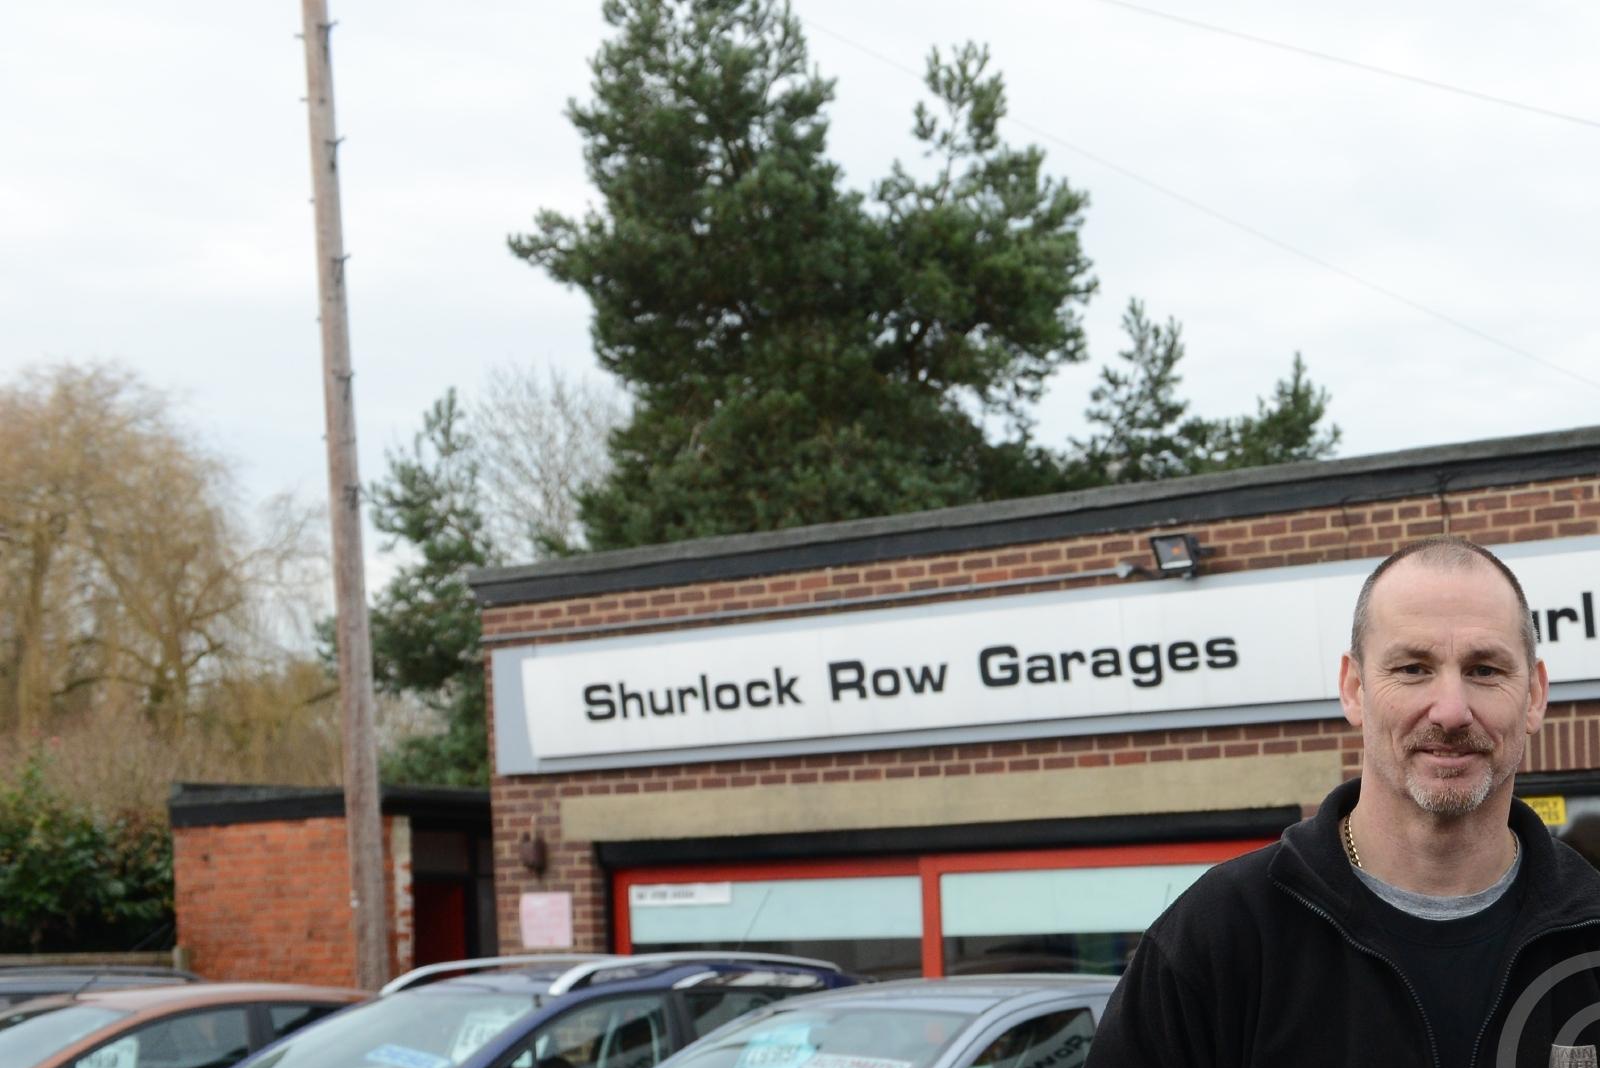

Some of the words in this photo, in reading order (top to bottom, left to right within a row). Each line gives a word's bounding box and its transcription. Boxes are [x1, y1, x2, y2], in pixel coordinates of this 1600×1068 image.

[582, 667, 802, 722] Shurlock
[827, 660, 949, 703] Row
[978, 636, 1240, 689] Garages
